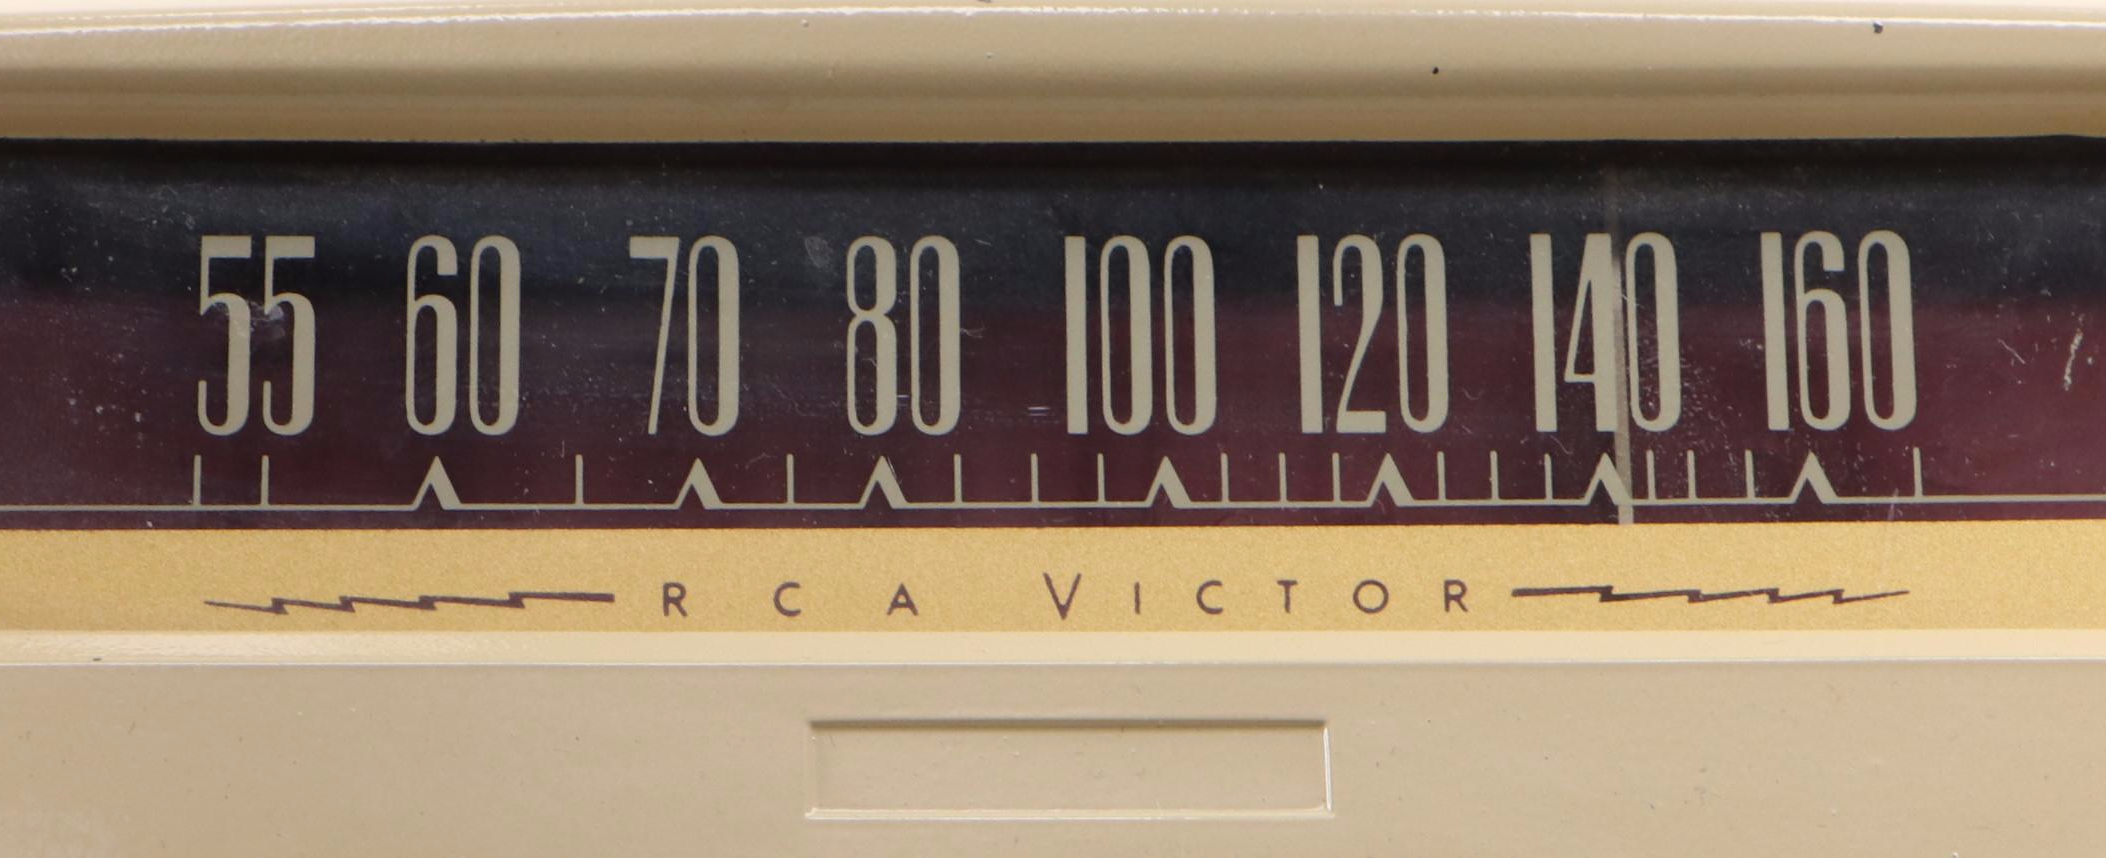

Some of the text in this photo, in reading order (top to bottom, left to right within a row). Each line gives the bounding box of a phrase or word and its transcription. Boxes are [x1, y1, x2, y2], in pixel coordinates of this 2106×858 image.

[197, 230, 1918, 436] 55 60 70 80 100 120 140 160
[662, 572, 1470, 620] RCA VICTOR
